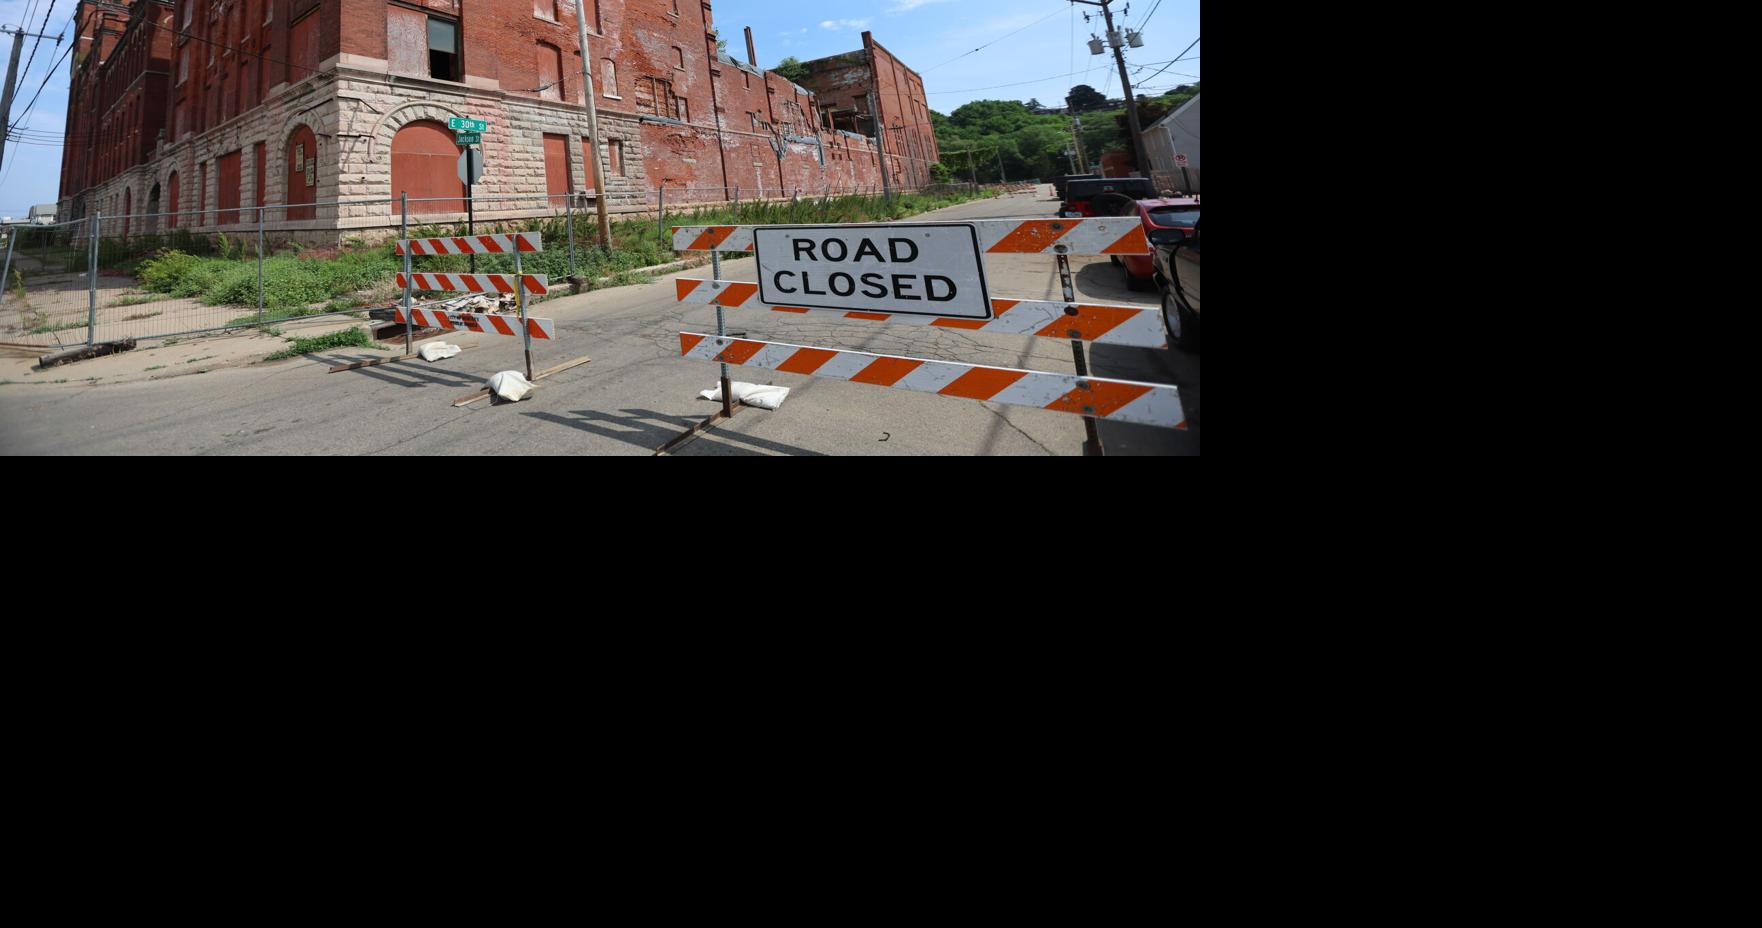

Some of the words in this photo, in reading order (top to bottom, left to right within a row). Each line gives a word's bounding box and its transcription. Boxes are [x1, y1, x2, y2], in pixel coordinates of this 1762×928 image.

[451, 119, 456, 128] E
[461, 119, 475, 129] 30th
[478, 121, 485, 131] St
[792, 237, 919, 263] ROAD
[773, 270, 957, 302] CLOSED
